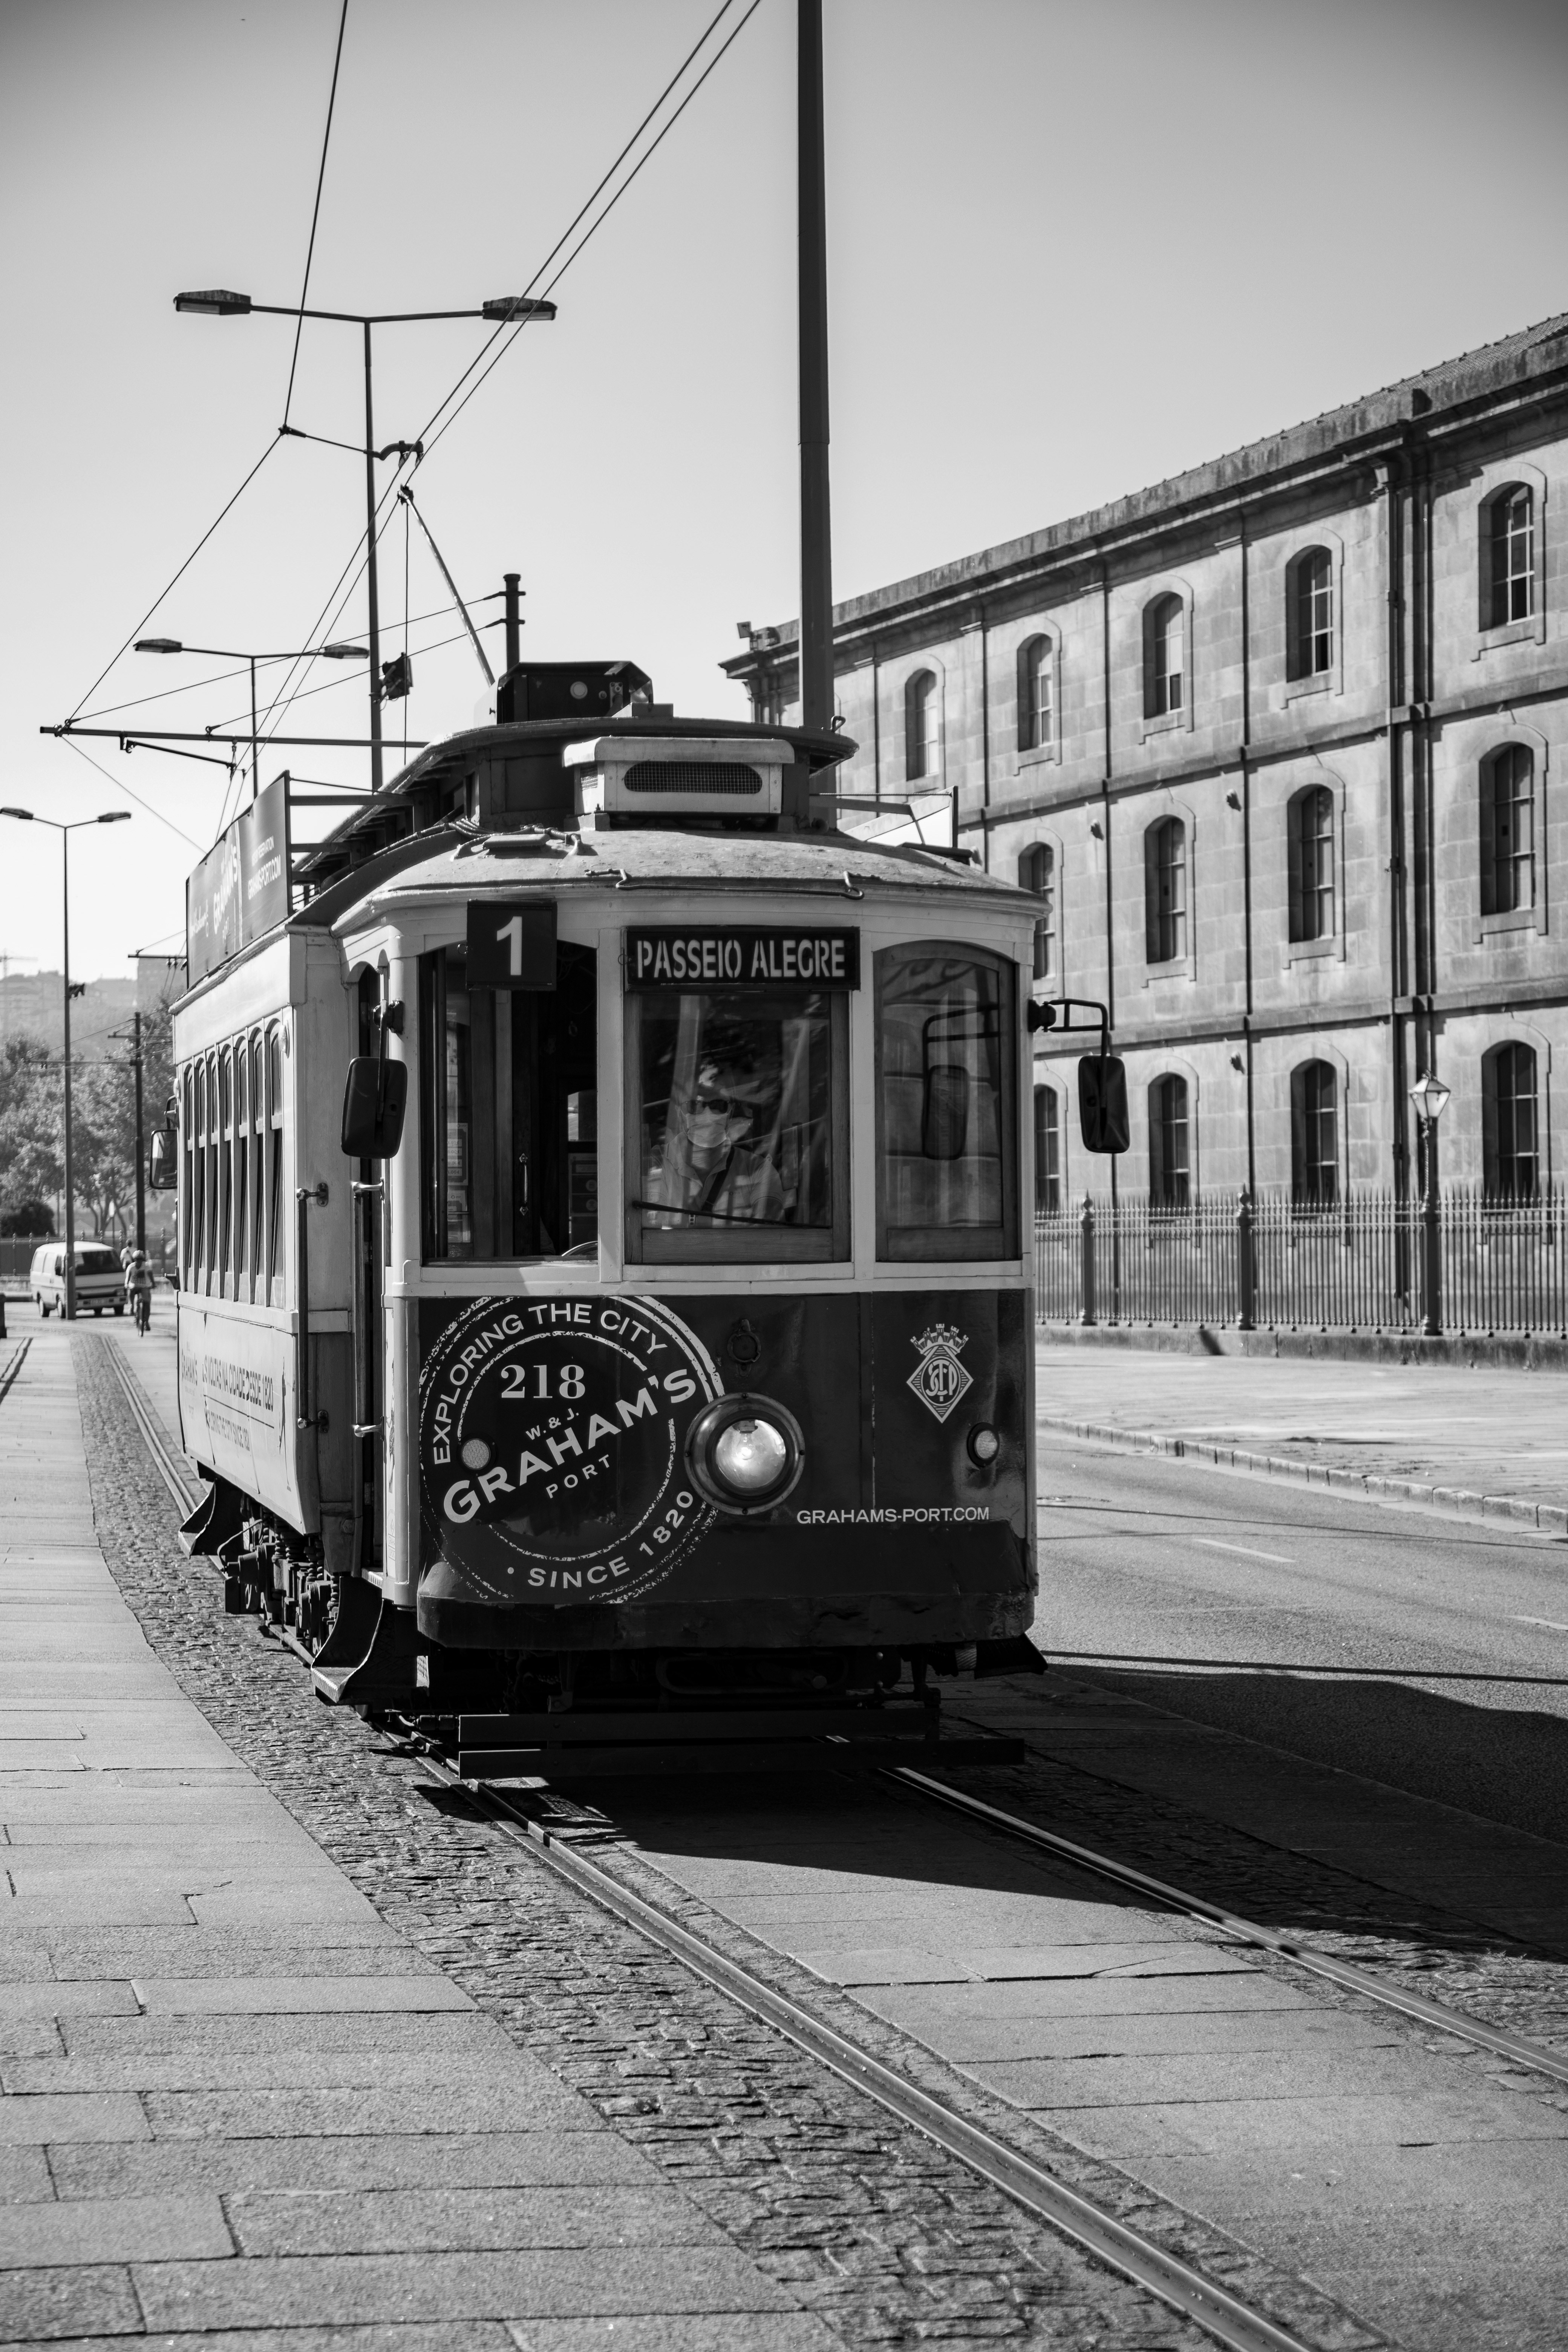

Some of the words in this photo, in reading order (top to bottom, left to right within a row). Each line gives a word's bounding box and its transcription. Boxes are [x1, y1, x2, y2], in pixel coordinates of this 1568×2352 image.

[497, 916, 522, 975] 1
[637, 940, 741, 978] PASSEIO
[751, 940, 844, 977] ALEGRE
[207, 1355, 222, 1390] VOLTAS
[222, 1361, 228, 1393] NA
[229, 1363, 245, 1400] CIDADE
[246, 1369, 261, 1407] DESDE
[262, 1374, 274, 1412] 1820
[433, 1314, 524, 1464] EXPLORING
[528, 1303, 592, 1325] THE
[600, 1310, 668, 1354] CITY
[501, 1364, 585, 1399] 218
[204, 1408, 220, 1436] XPLORING
[548, 1417, 561, 1429] &
[567, 1408, 579, 1420] J.
[443, 1369, 696, 1523] GRAHAM'S
[546, 1454, 609, 1499] PORT
[797, 1507, 989, 1524] GRAHAMS-PORT.COM
[528, 1556, 630, 1589] SINCE
[639, 1491, 693, 1556] 1820
